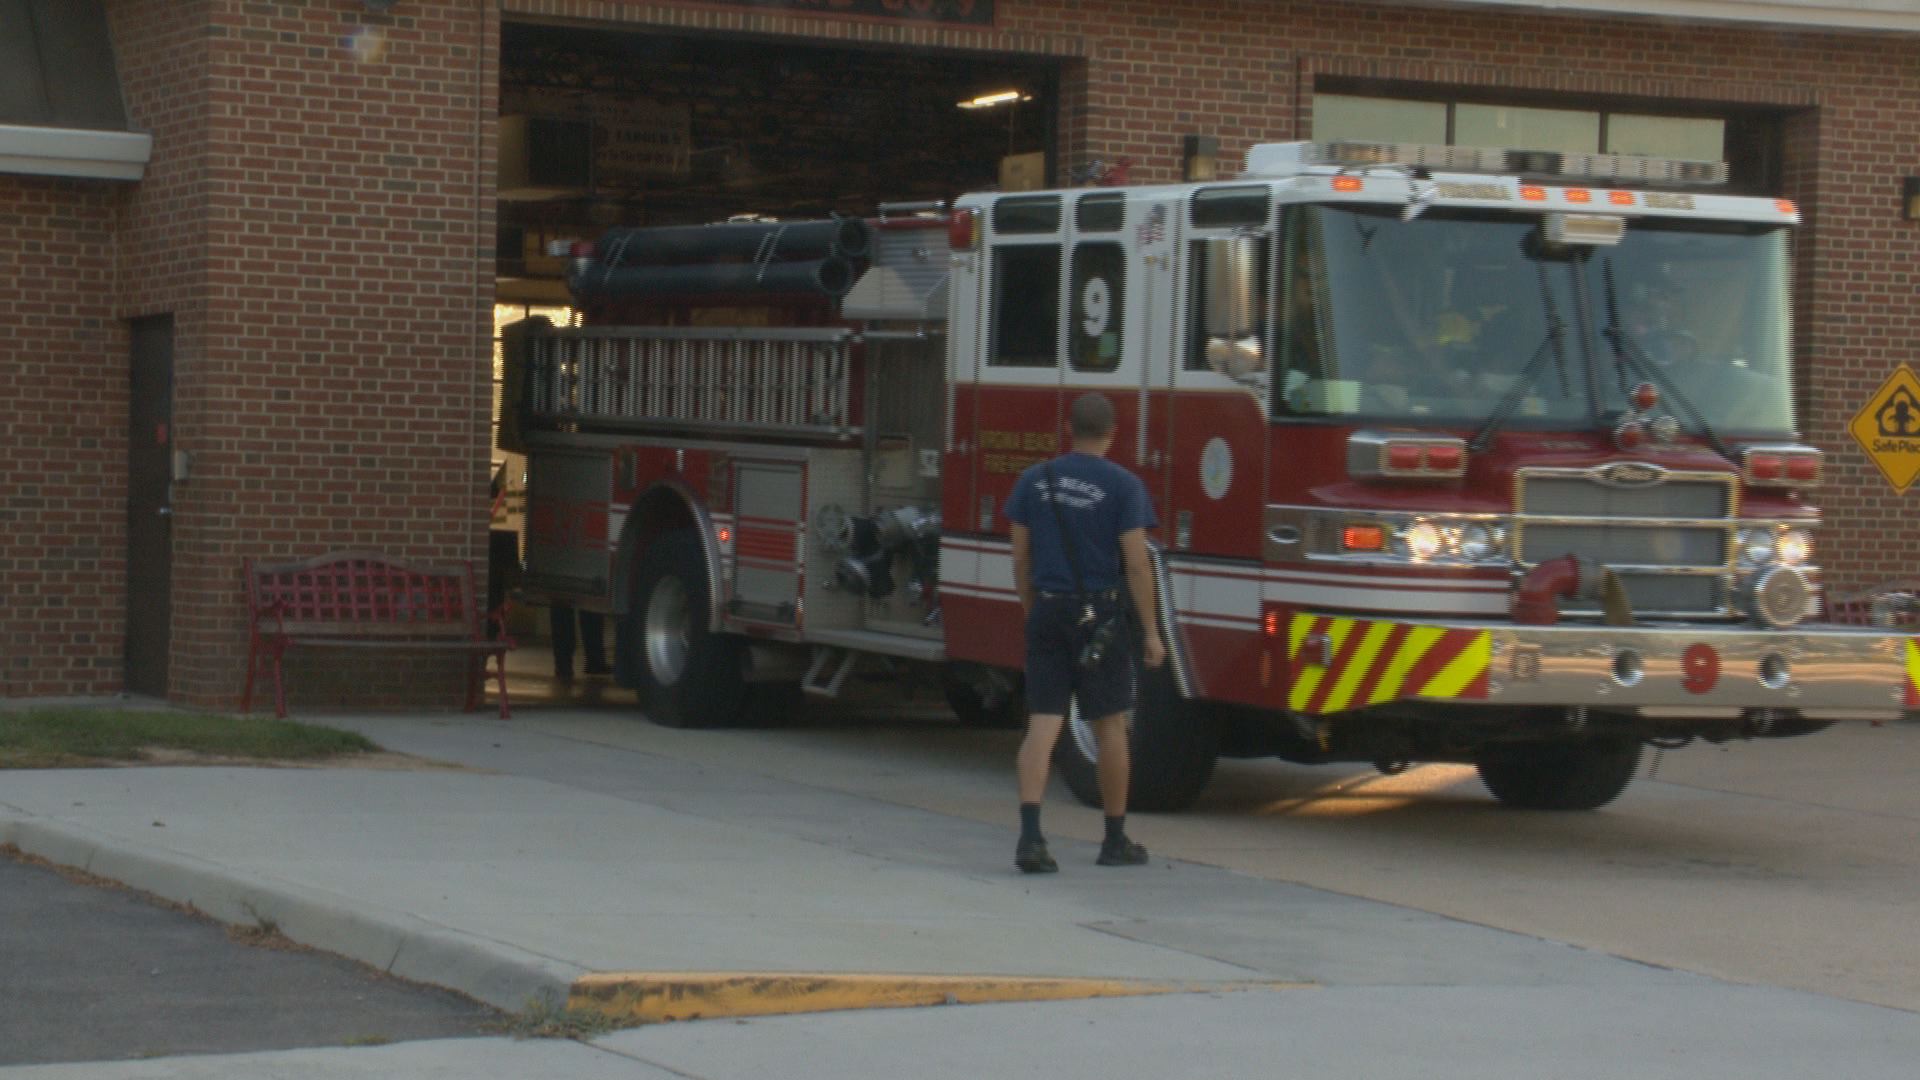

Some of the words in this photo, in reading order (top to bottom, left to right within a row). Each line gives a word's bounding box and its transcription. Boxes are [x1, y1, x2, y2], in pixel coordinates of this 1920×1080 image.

[1082, 277, 1110, 337] 9
[1872, 439, 1898, 452] Safe
[1681, 642, 1722, 695] 9
